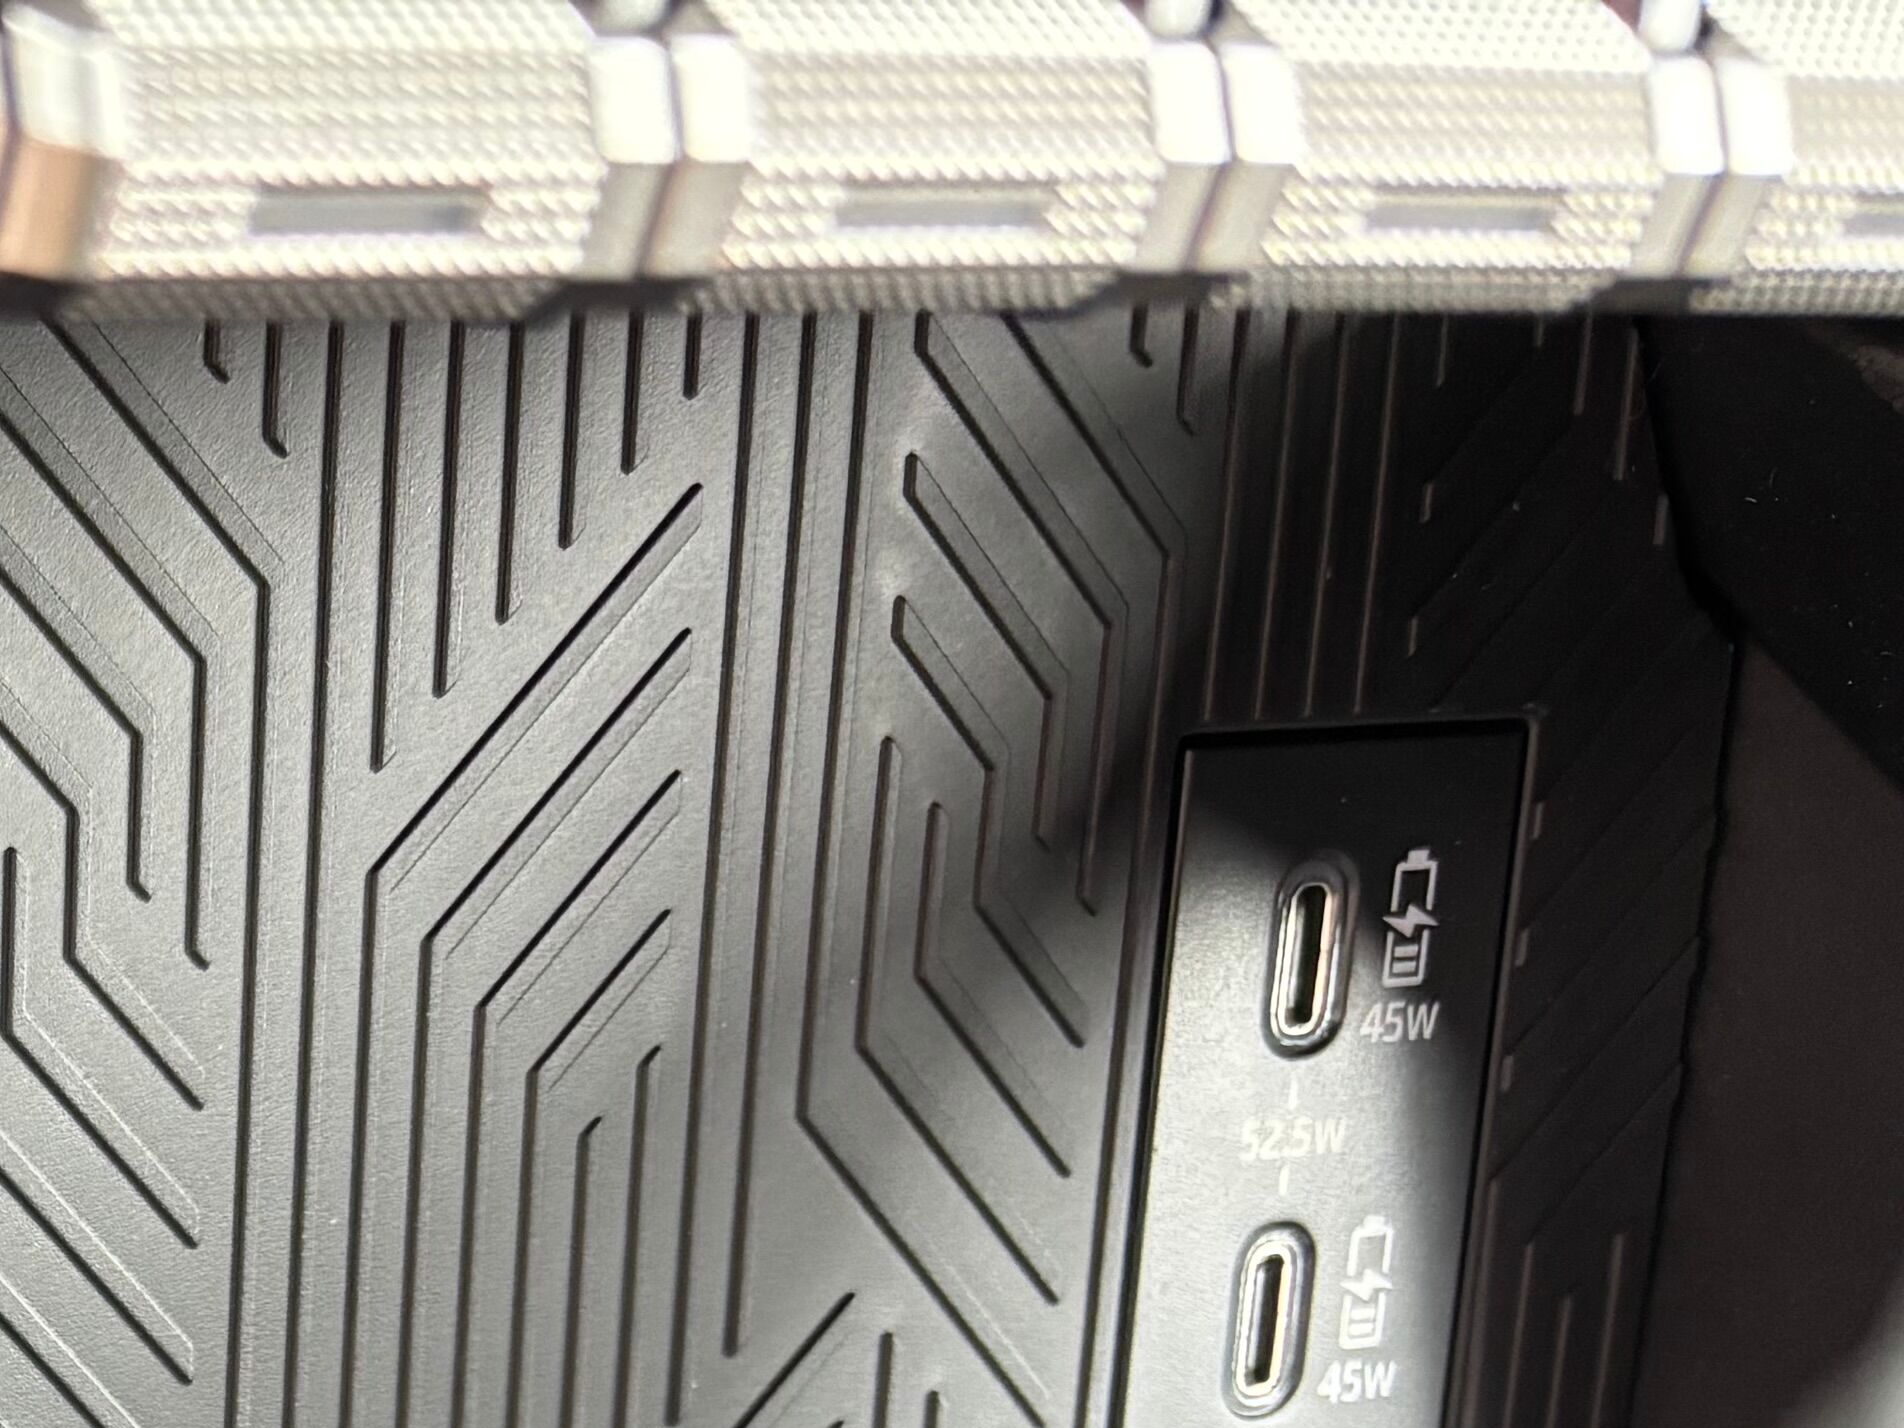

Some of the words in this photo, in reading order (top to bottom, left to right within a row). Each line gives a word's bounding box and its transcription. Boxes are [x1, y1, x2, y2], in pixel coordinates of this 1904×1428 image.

[1359, 1001, 1440, 1043] 45W
[1240, 1115, 1347, 1161] 52.5W
[1316, 1358, 1397, 1404] 45W
